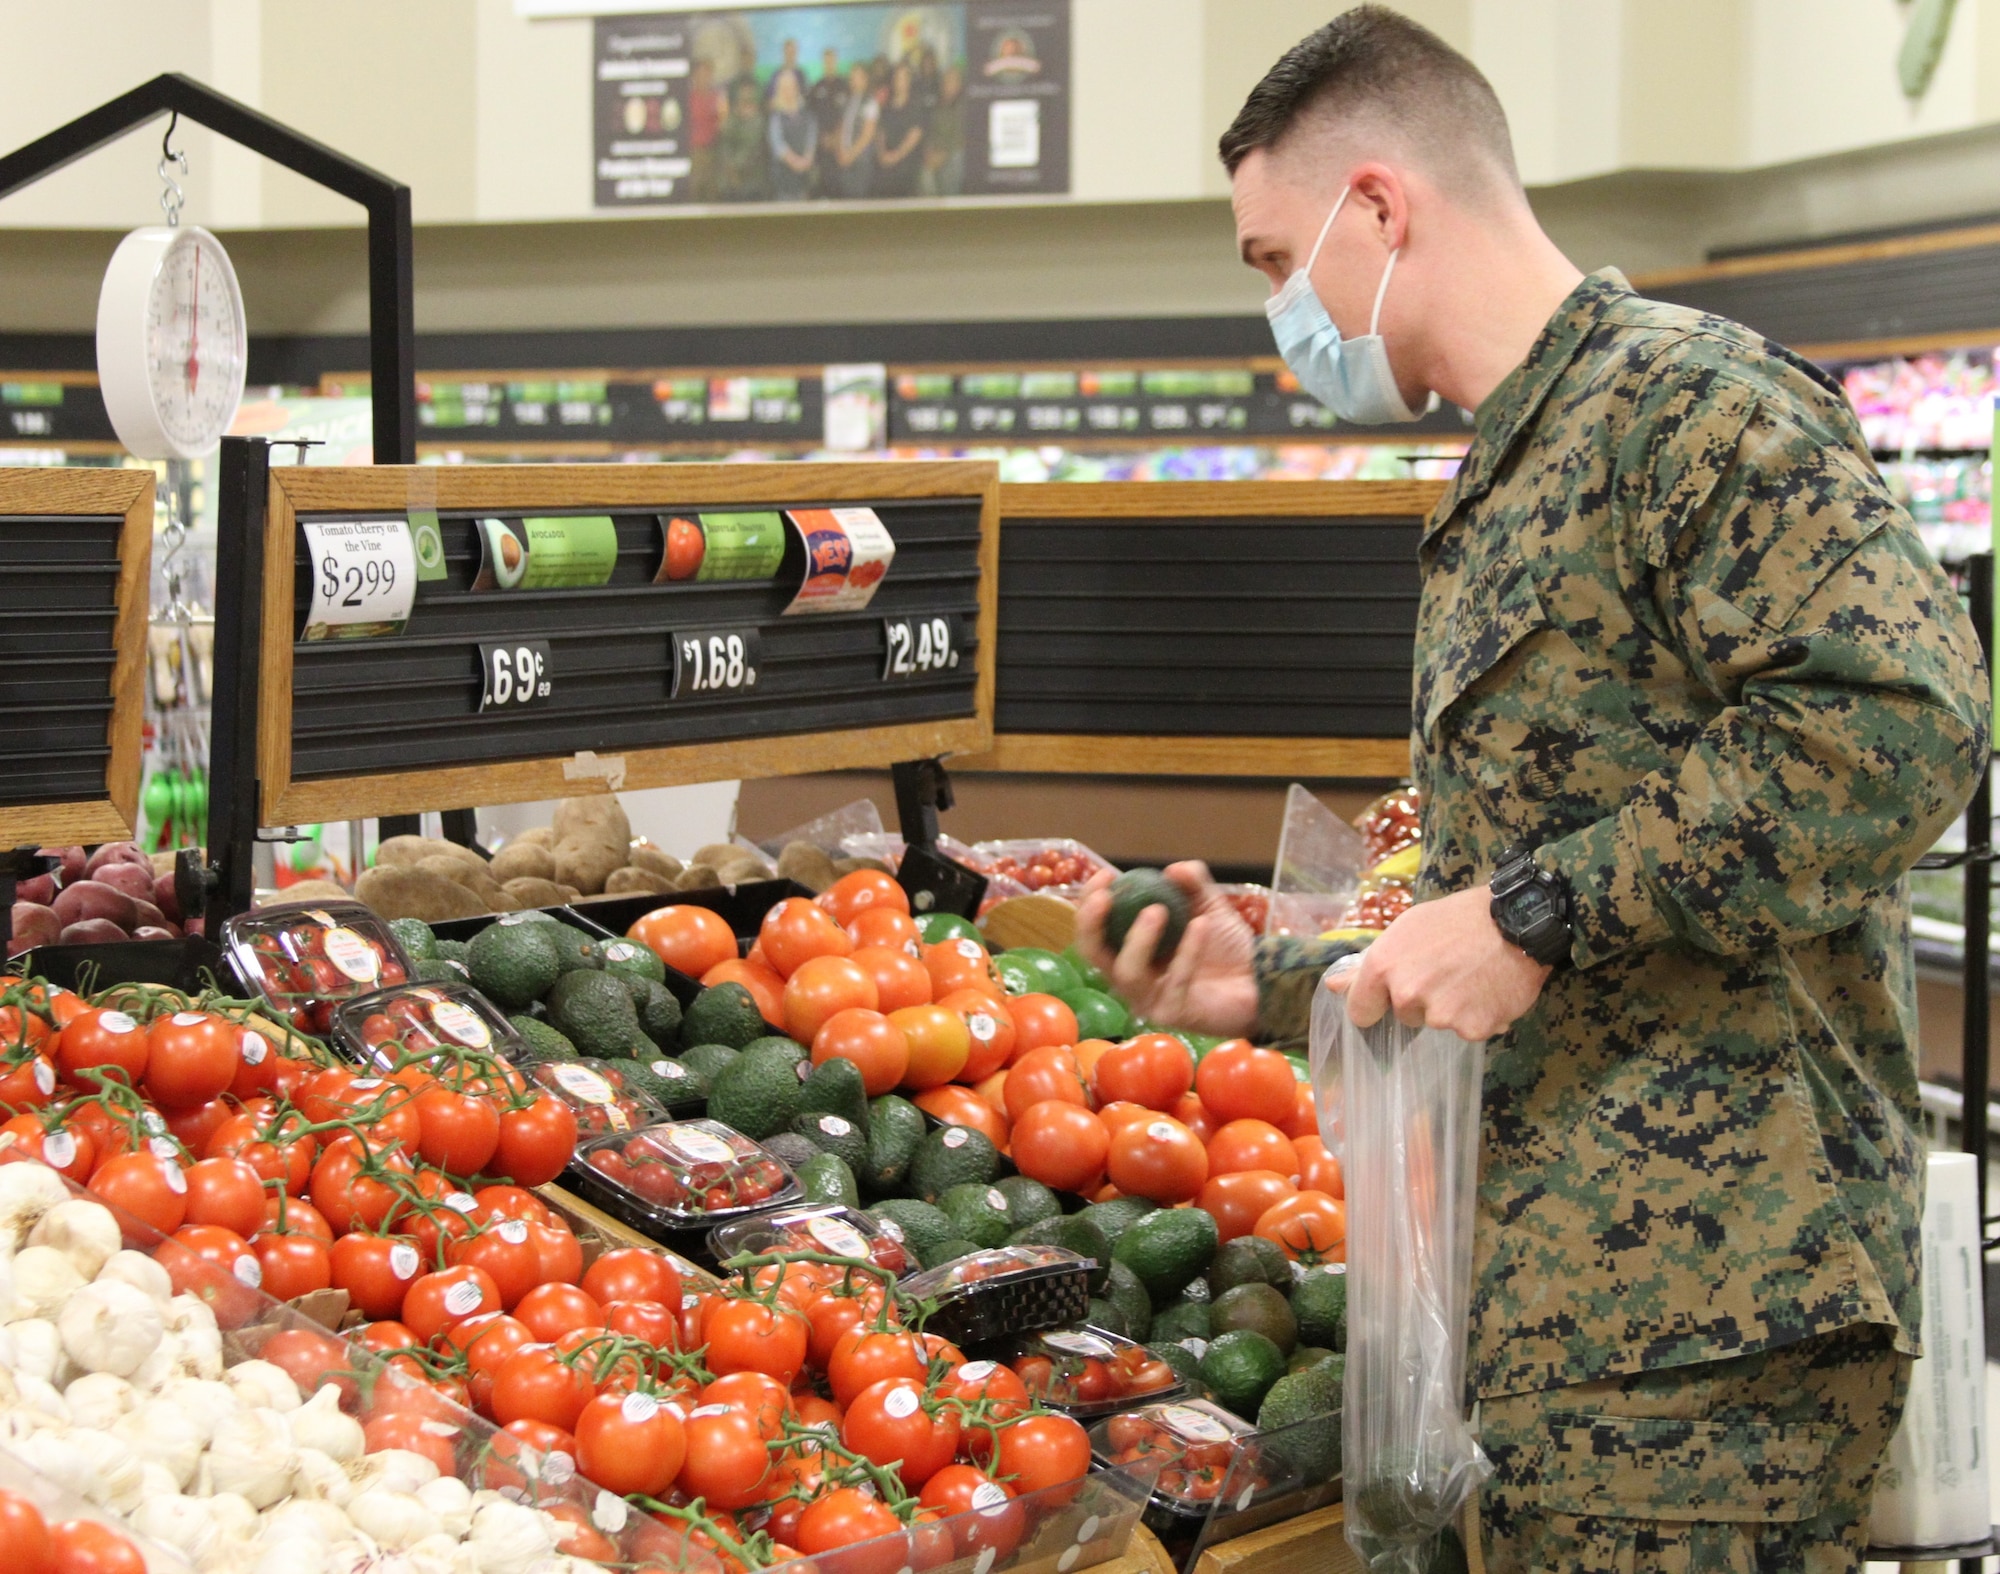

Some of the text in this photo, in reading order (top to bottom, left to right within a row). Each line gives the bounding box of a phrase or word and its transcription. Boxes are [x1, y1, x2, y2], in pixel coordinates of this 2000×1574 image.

[317, 521, 399, 536] Tomato Cherry on
[344, 540, 382, 552] the Vine
[682, 634, 744, 690] $1.68
